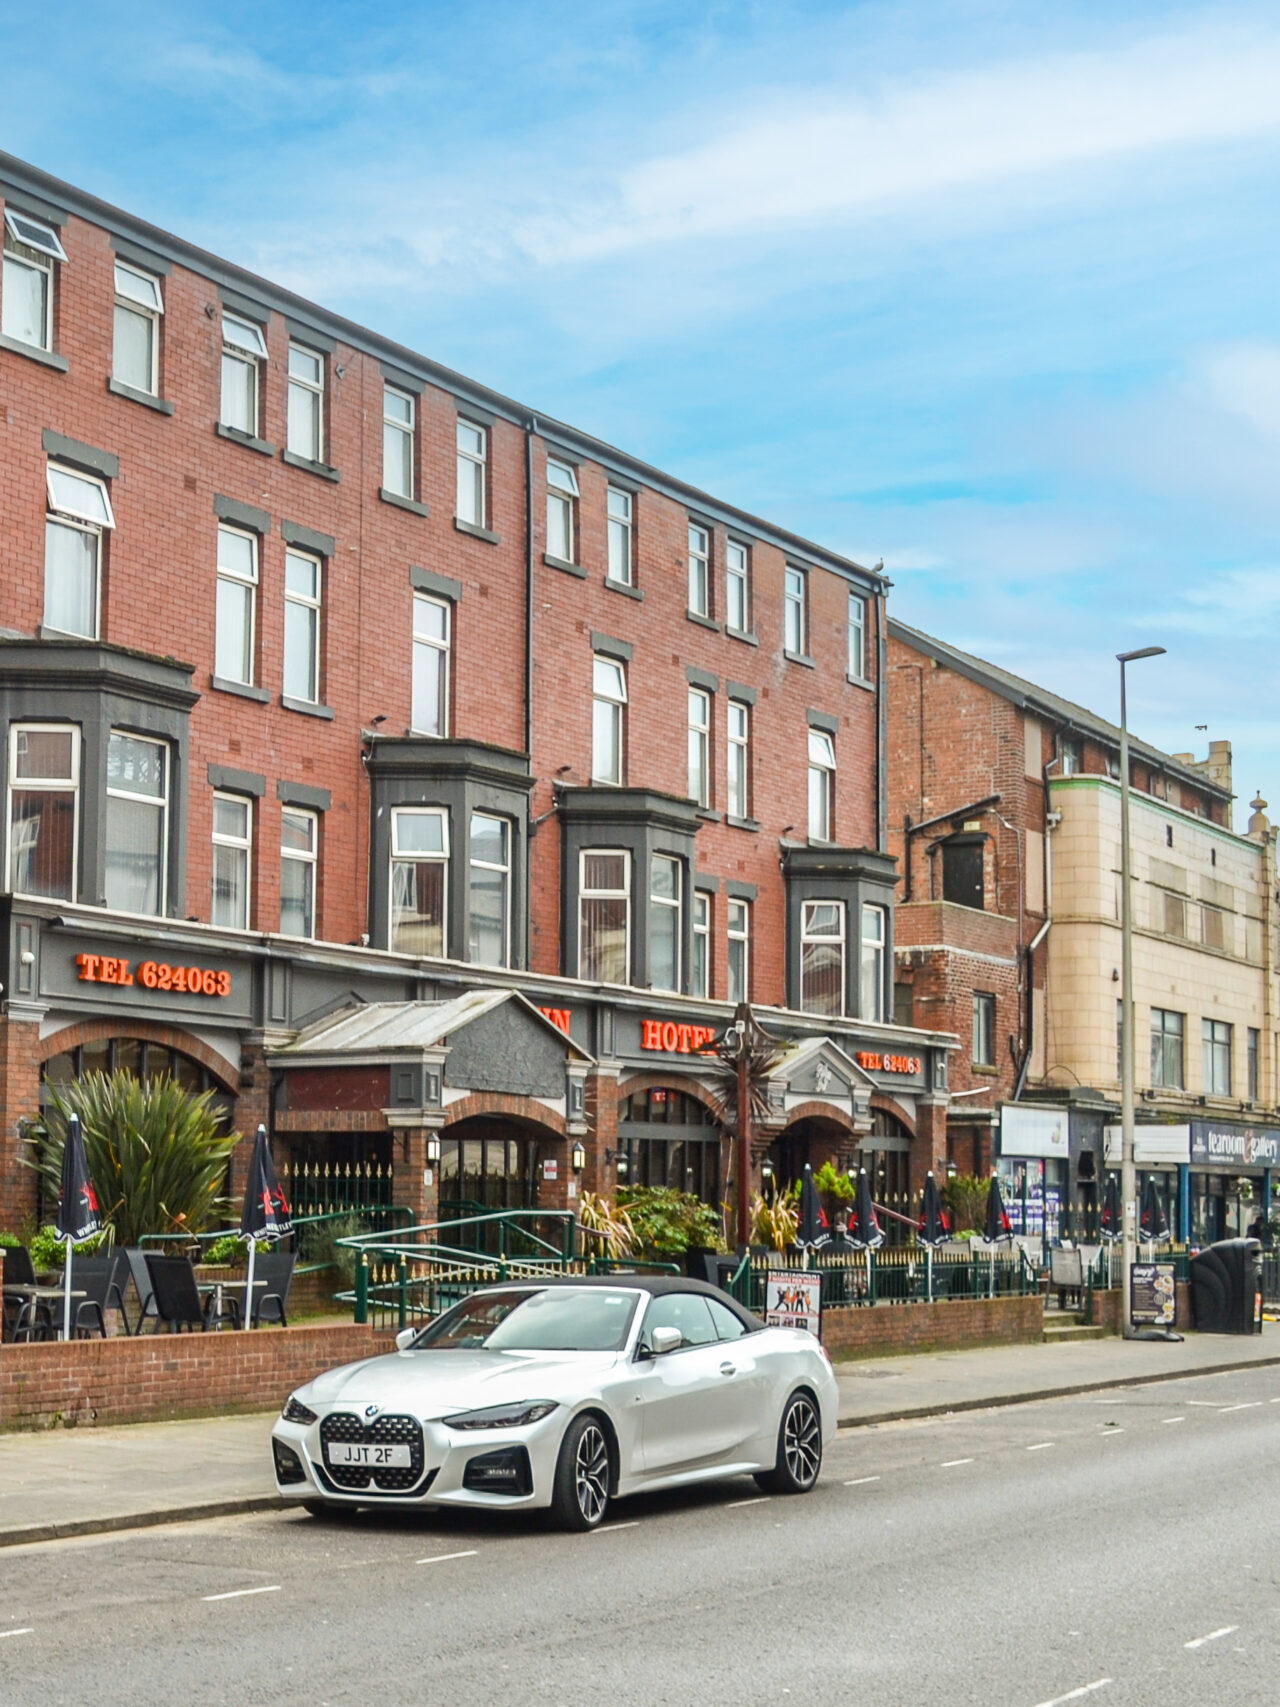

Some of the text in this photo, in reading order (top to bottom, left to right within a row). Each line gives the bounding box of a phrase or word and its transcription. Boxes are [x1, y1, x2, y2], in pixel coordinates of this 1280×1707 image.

[76, 953, 232, 997] TEL 624063
[856, 1051, 921, 1075] TEL 624063
[1208, 1130, 1245, 1154] tearoom
[1251, 1135, 1277, 1164] gallery
[344, 1446, 393, 1463] JJT 2F
